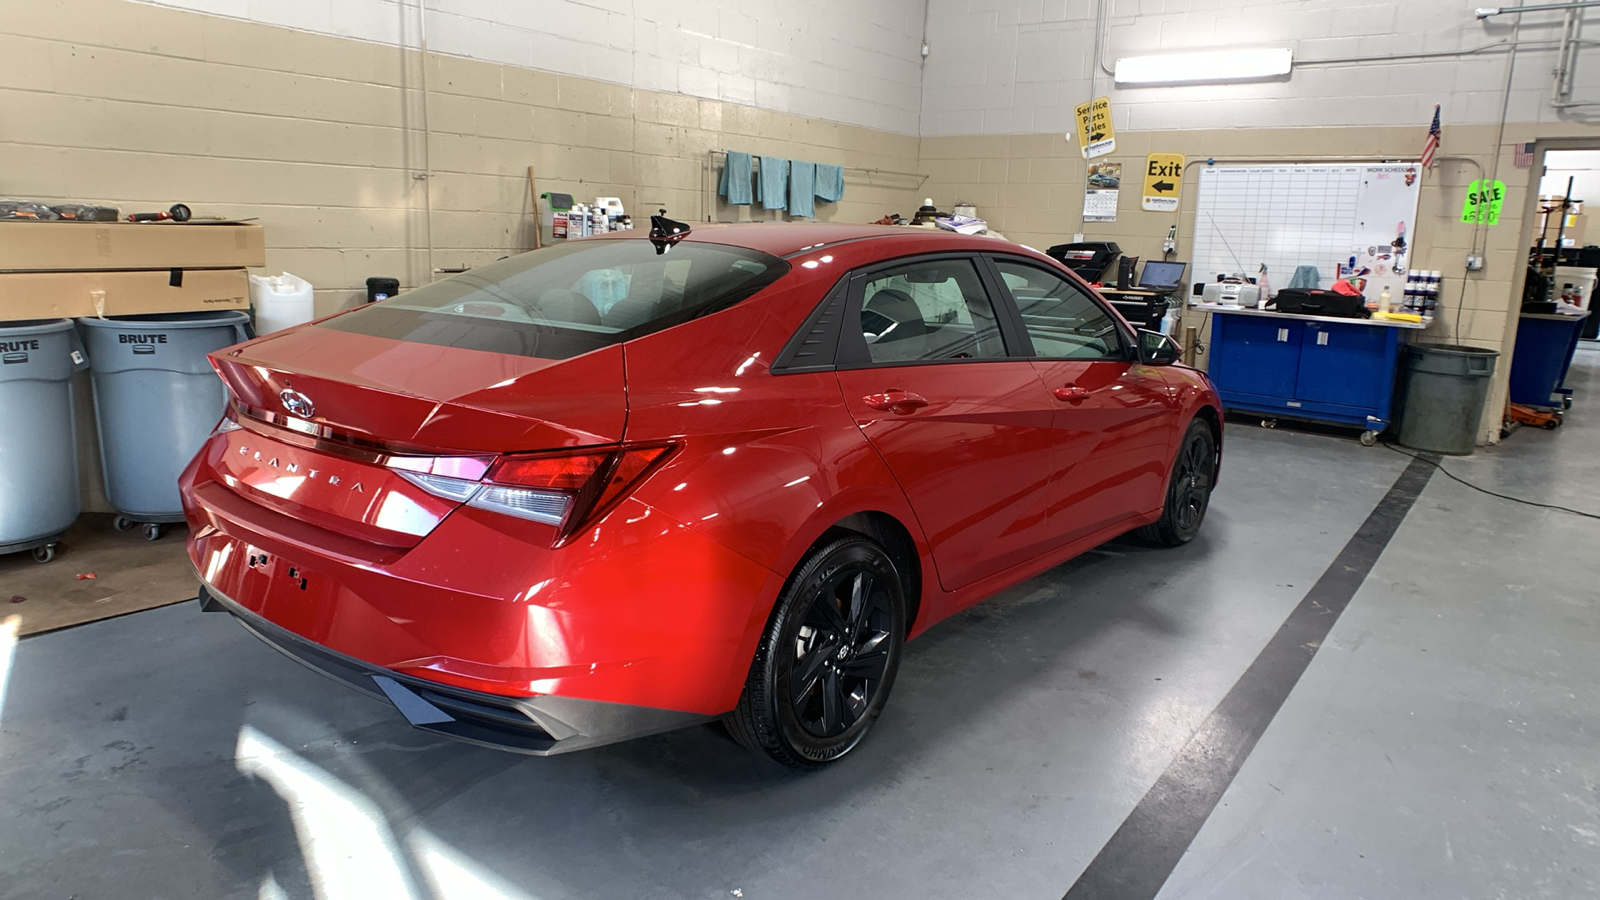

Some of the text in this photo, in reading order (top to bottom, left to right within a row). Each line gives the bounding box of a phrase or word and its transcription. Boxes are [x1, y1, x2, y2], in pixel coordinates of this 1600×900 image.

[1148, 160, 1182, 177] Exit
[1469, 188, 1501, 205] SALE
[0, 340, 39, 352] RUTE
[119, 334, 167, 344] BRUTE
[239, 445, 364, 493] ELANTRA
[803, 743, 845, 759] KUMHO
